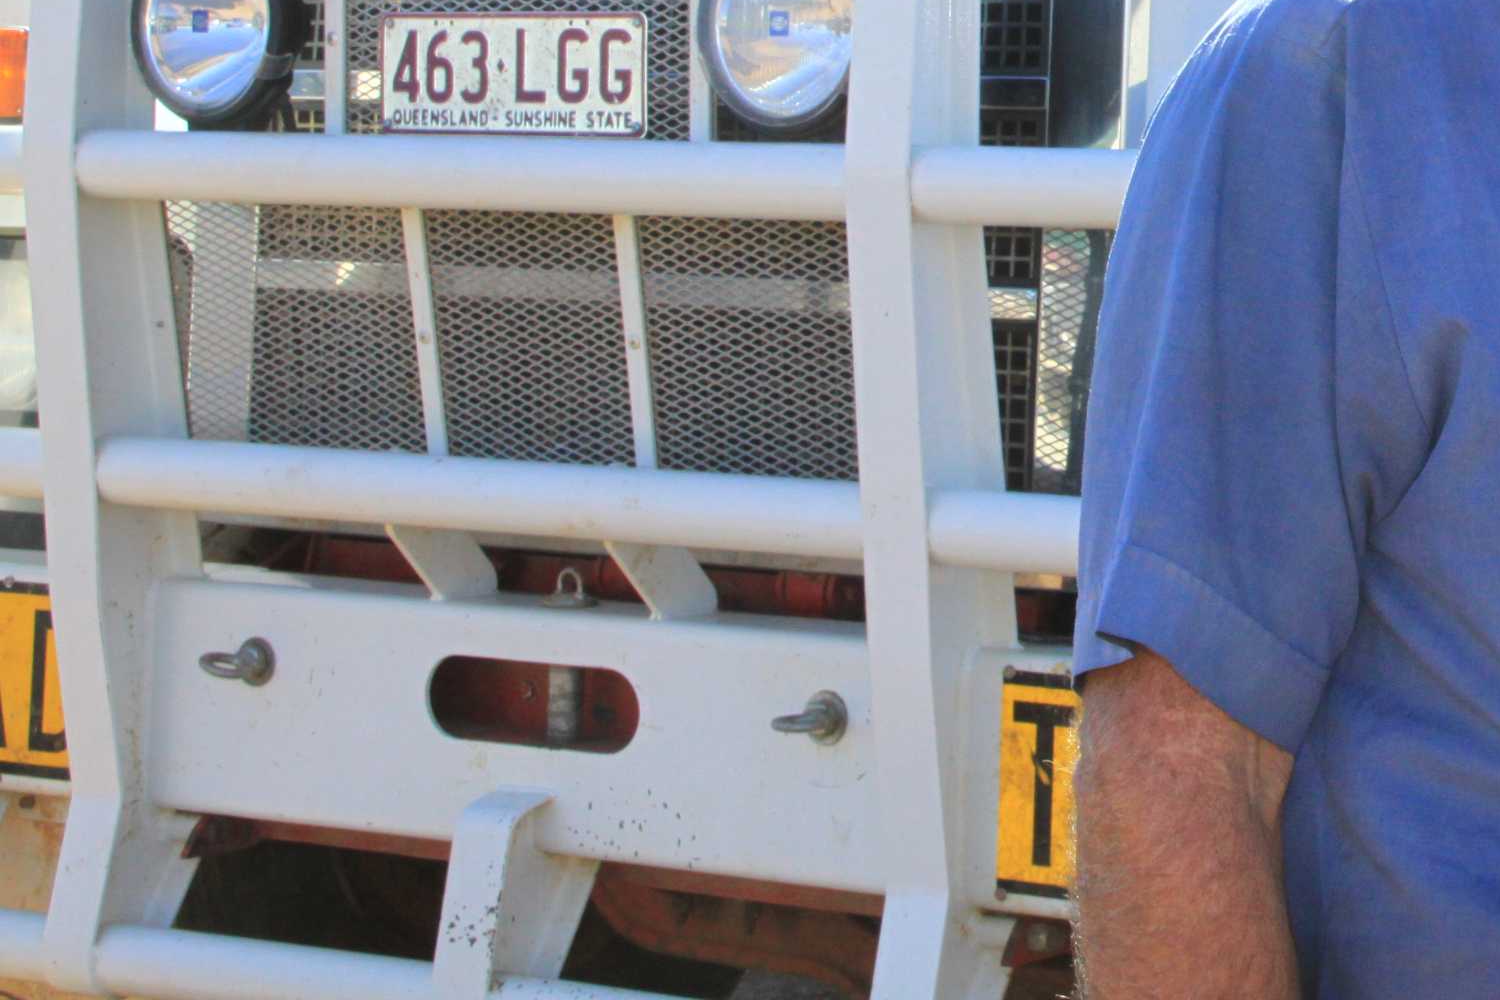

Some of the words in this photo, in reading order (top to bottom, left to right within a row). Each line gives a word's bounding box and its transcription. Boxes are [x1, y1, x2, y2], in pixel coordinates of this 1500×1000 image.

[392, 110, 489, 128] QUEENSLAND
[505, 111, 576, 128] SUNSHINE
[586, 112, 632, 129] STATE
